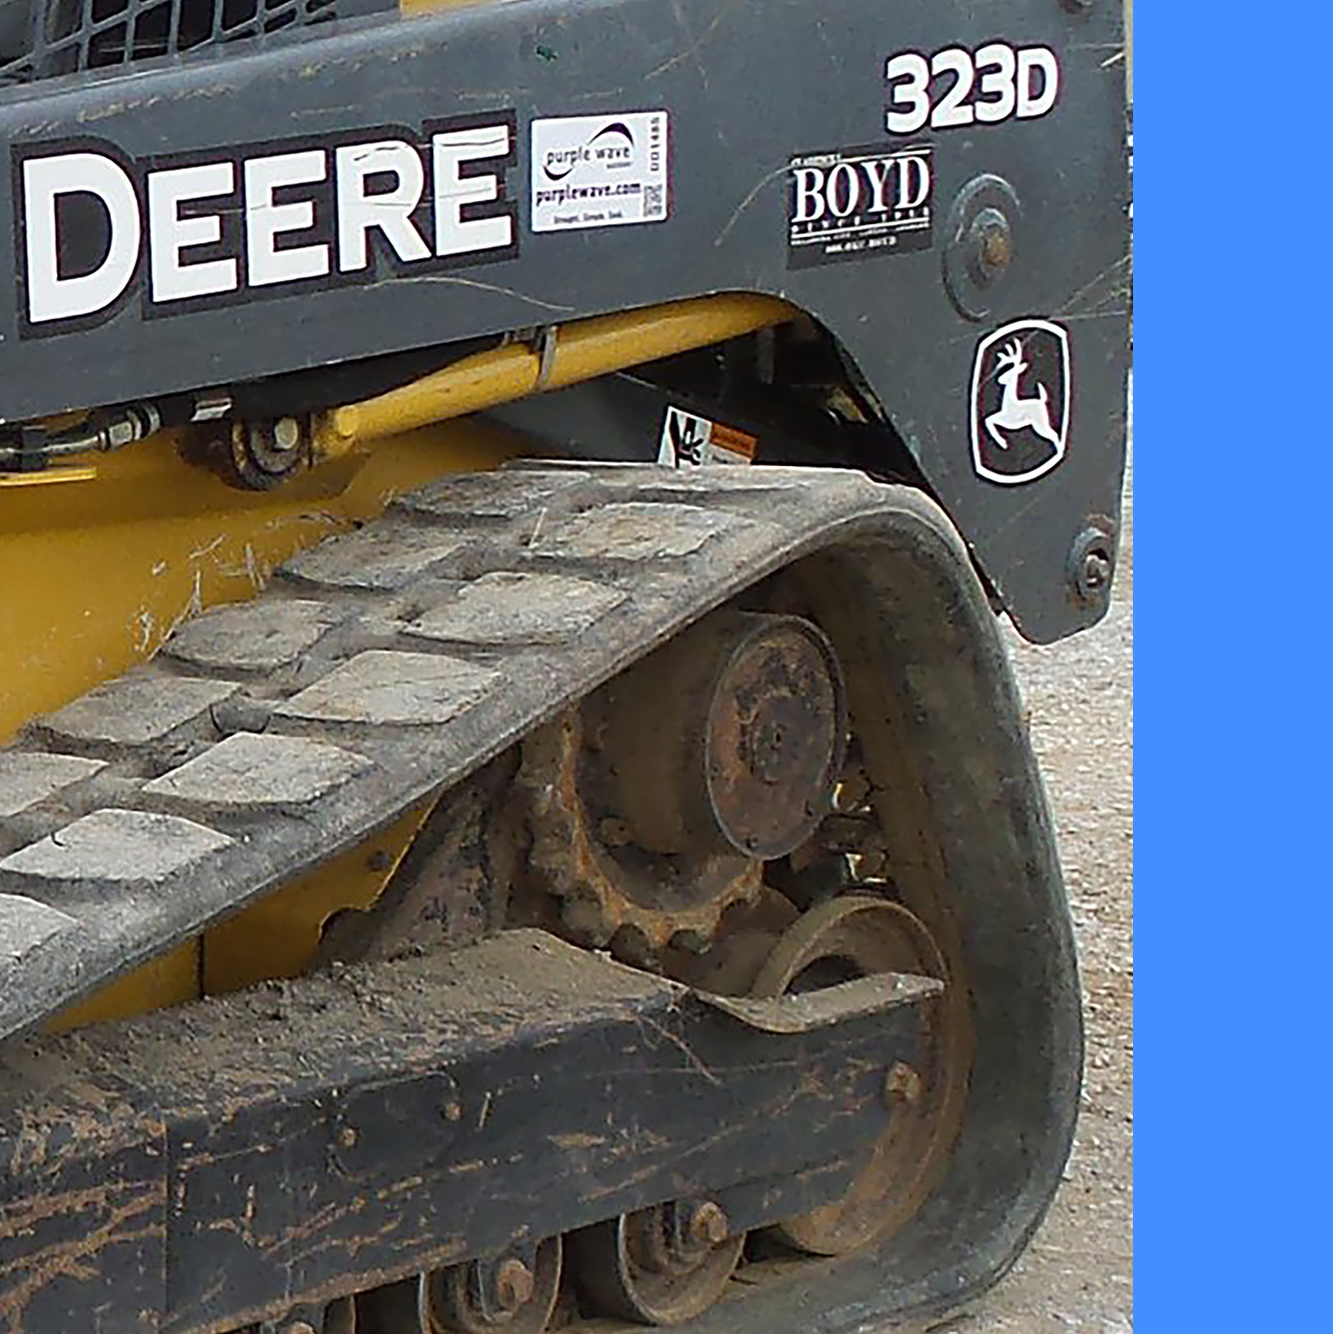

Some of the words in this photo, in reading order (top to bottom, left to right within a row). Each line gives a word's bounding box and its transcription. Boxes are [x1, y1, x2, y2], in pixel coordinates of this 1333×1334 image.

[886, 43, 1059, 133] 323D
[546, 145, 591, 166] purple
[595, 146, 631, 160] wave
[791, 155, 931, 223] BOYD
[23, 124, 513, 324] DEERE
[535, 182, 642, 208] purplewave.com
